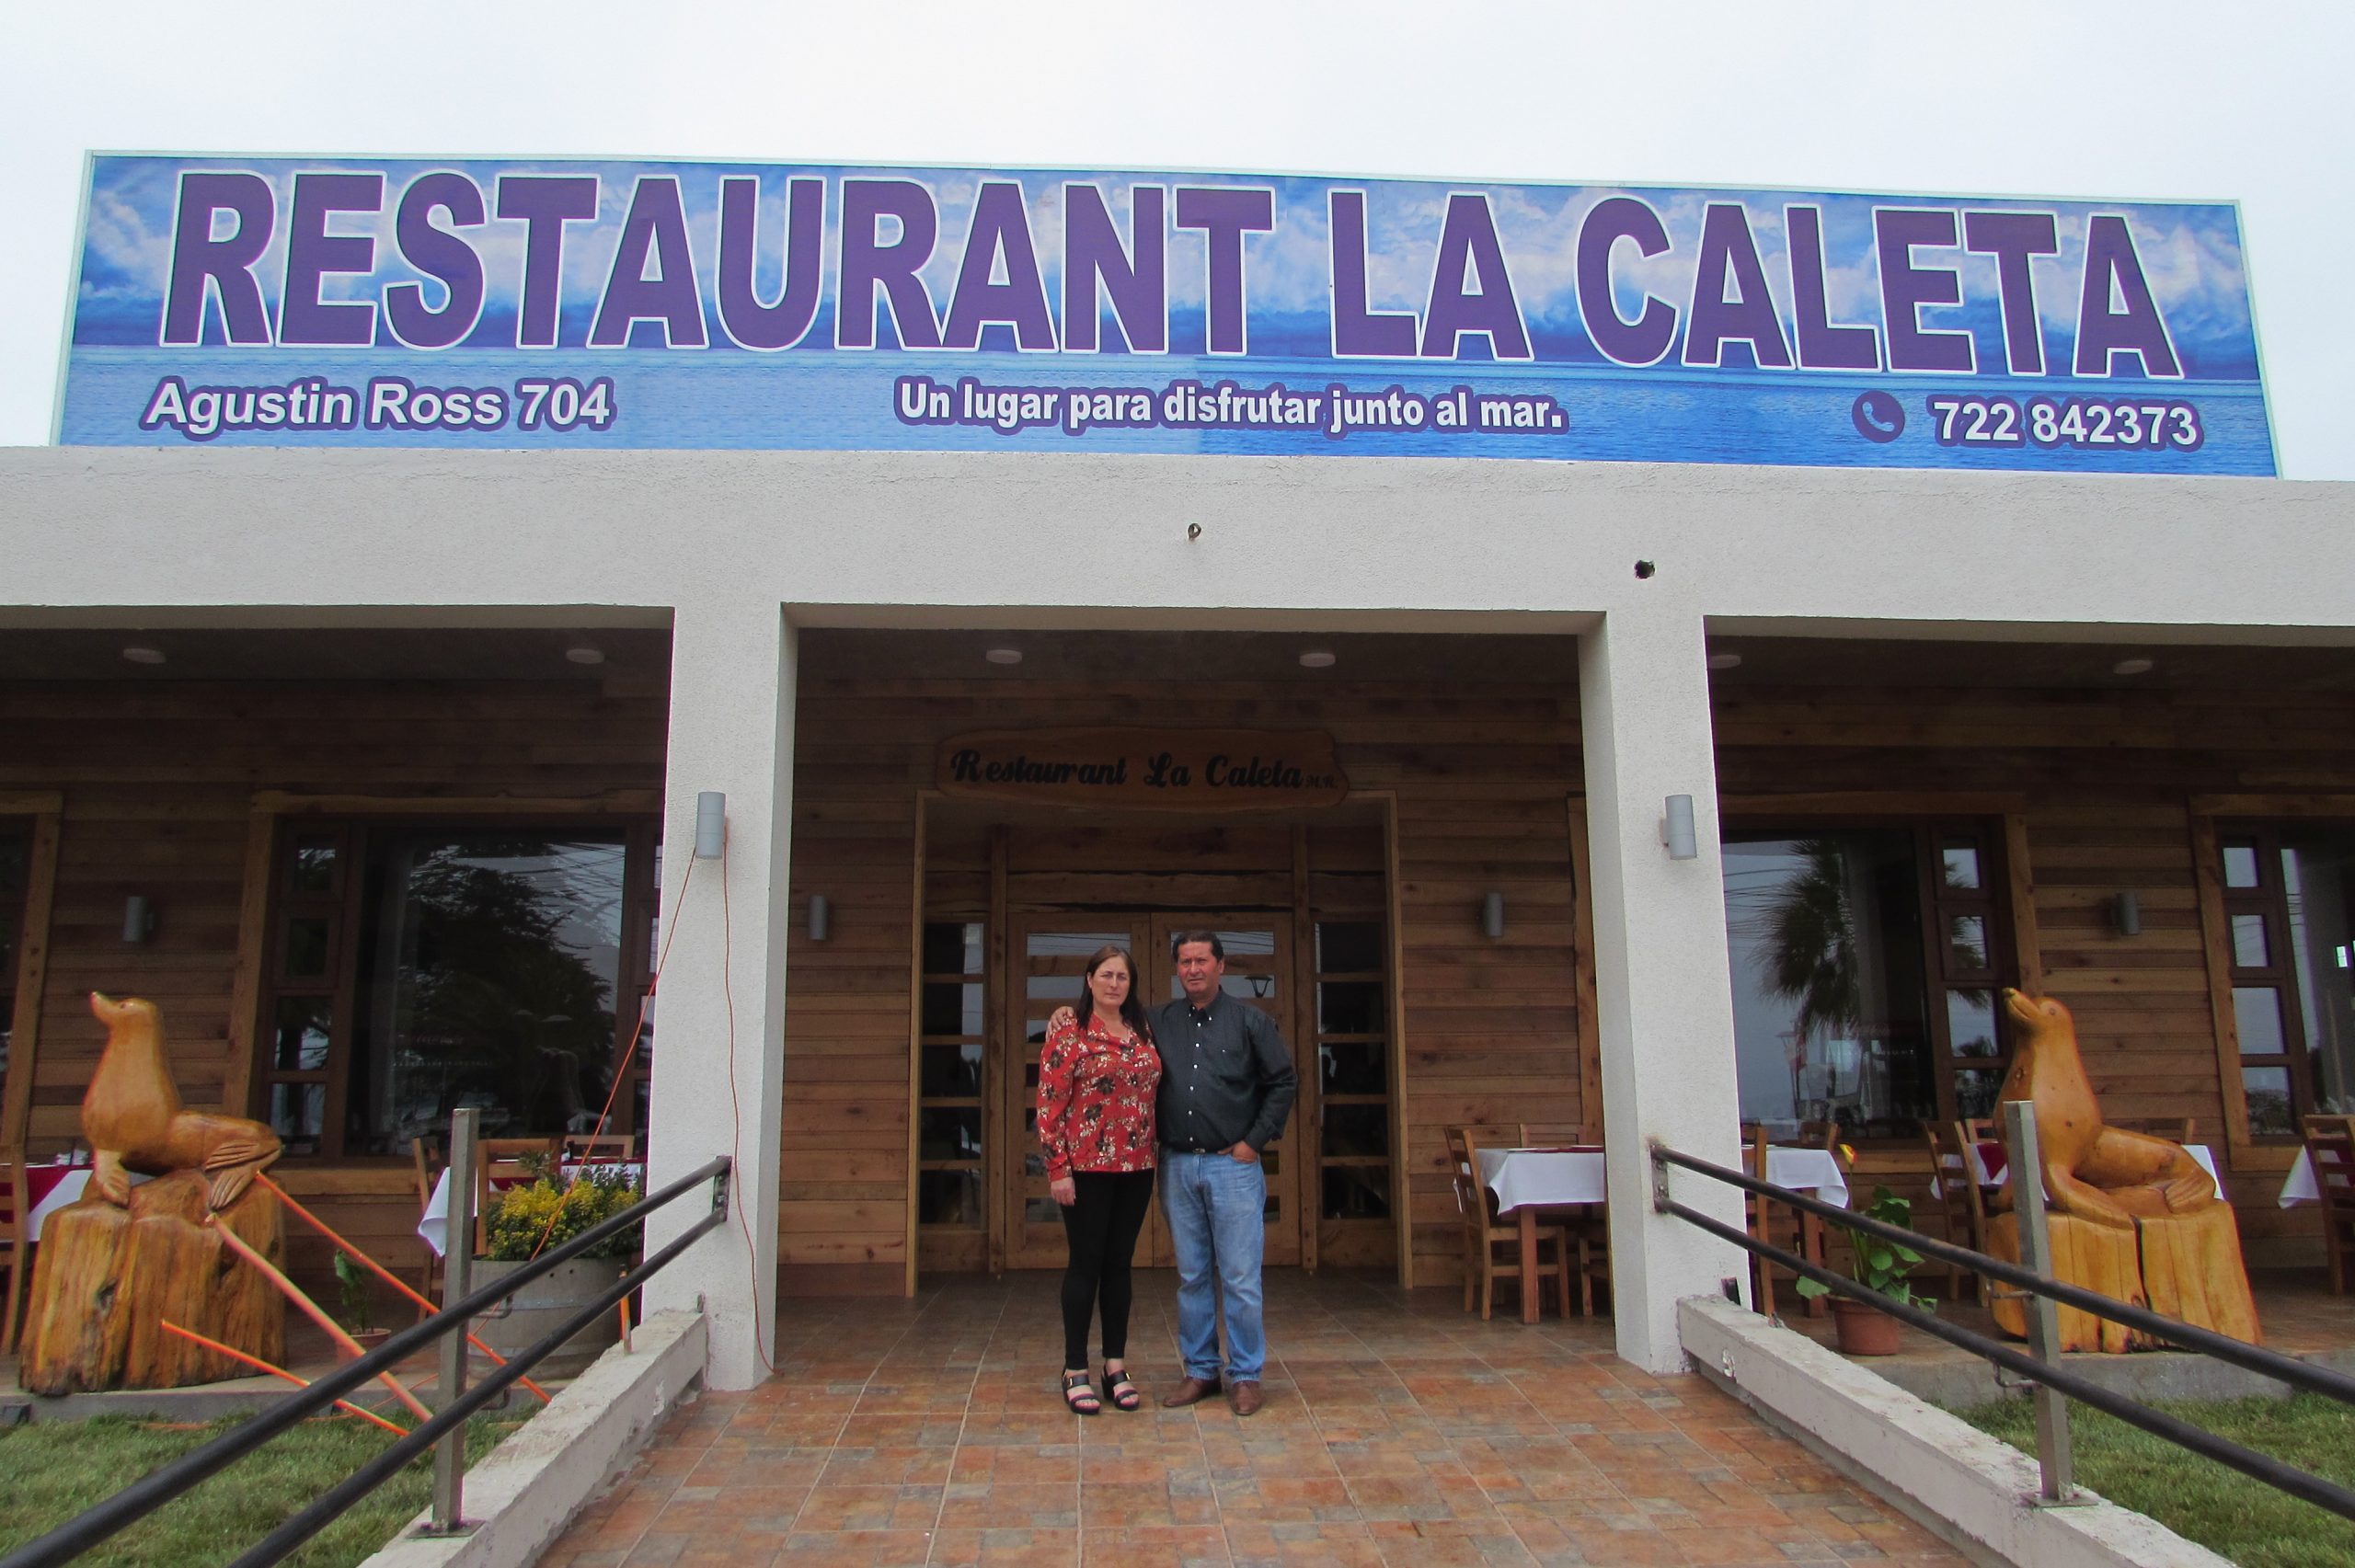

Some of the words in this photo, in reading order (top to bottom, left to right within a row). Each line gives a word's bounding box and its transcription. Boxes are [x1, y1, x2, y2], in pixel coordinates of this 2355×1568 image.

[160, 169, 1276, 356] RESTAURANT
[1327, 188, 1535, 361] LA
[1574, 194, 2185, 379] CALETA
[145, 382, 353, 435] Agustin
[370, 383, 503, 425] Ross
[521, 383, 611, 425] 704
[901, 383, 950, 418] Un
[963, 383, 1059, 429] lugar
[1069, 392, 1151, 429] para
[1163, 385, 1322, 424] disfrutar
[1329, 389, 1425, 433] junto
[1435, 392, 1468, 427] al
[1479, 399, 1563, 429] mar.
[1933, 401, 2019, 441] 722
[2030, 403, 2198, 446] 842373
[950, 749, 1128, 785] Restaurant
[1143, 751, 1191, 788] La
[1205, 754, 1304, 789] Caleta
